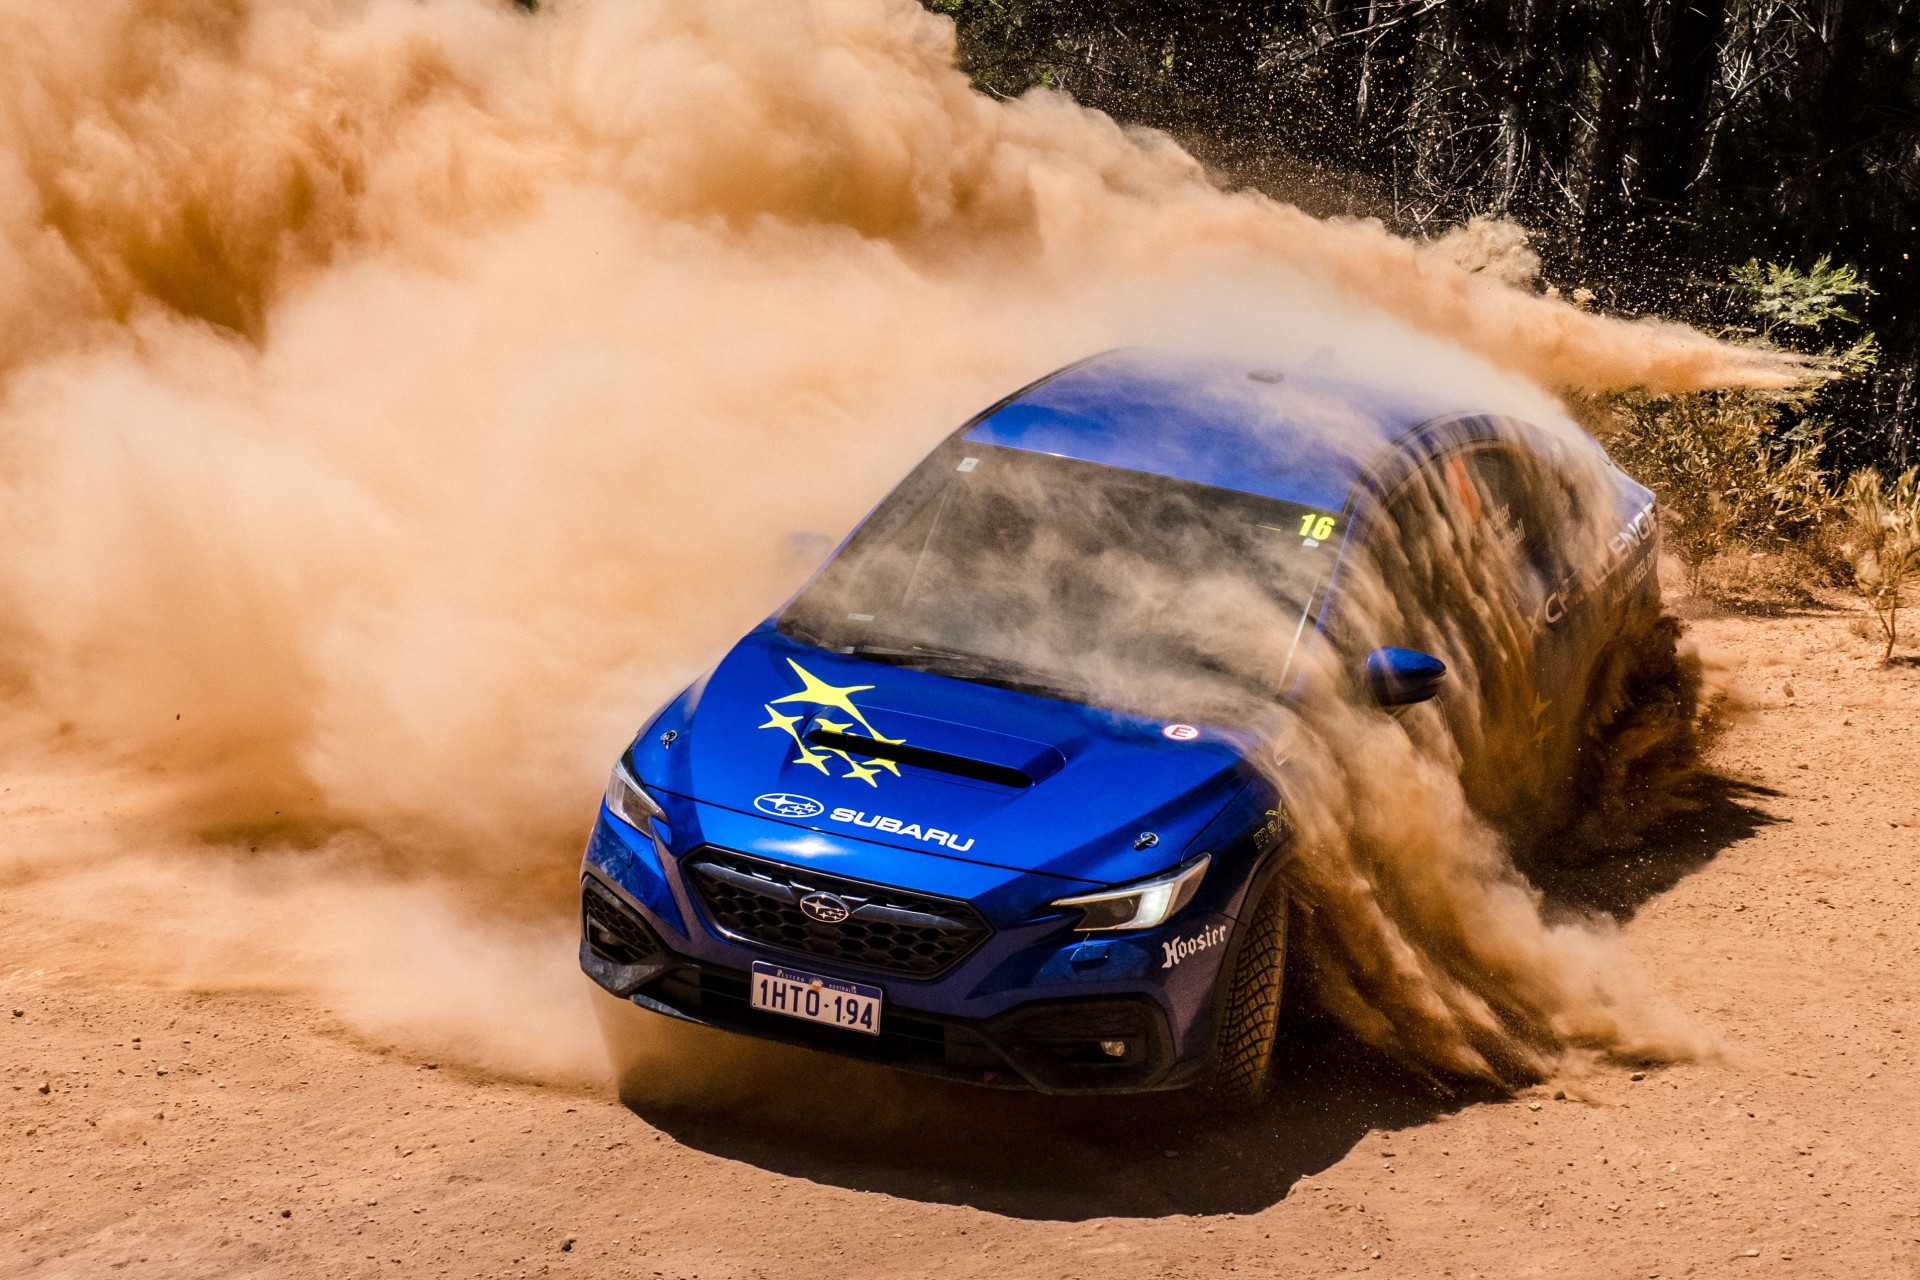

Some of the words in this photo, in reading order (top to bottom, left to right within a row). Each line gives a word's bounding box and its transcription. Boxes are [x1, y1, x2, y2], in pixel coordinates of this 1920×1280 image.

[1299, 513, 1335, 540] 16
[829, 807, 975, 852] SUBARU
[1162, 924, 1226, 969] Hoosier
